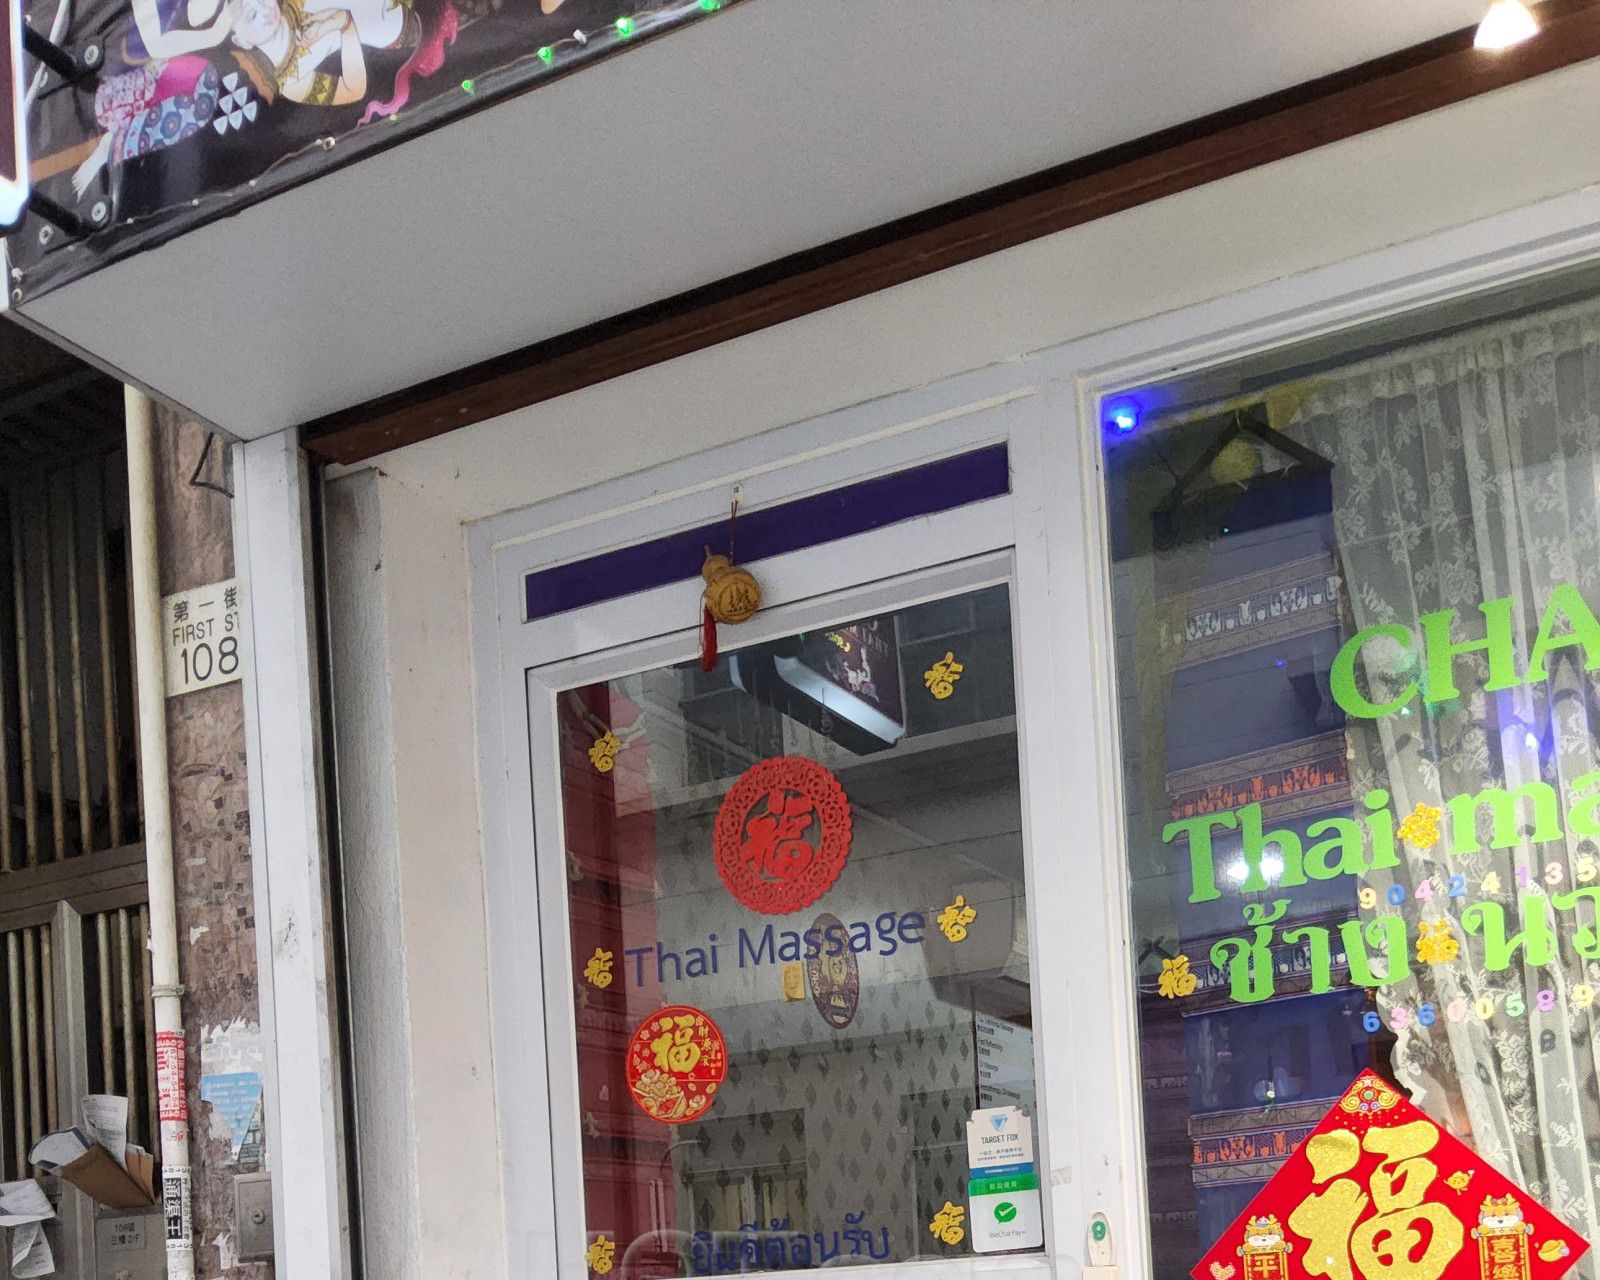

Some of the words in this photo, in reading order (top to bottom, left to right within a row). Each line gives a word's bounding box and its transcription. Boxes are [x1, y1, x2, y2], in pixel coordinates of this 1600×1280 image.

[172, 617, 216, 647] FIRST
[181, 636, 239, 685] 108
[1162, 789, 1401, 904] Thai
[625, 933, 719, 987] Thai
[737, 910, 927, 970] Massage
[1210, 899, 1412, 1004] ช้าง
